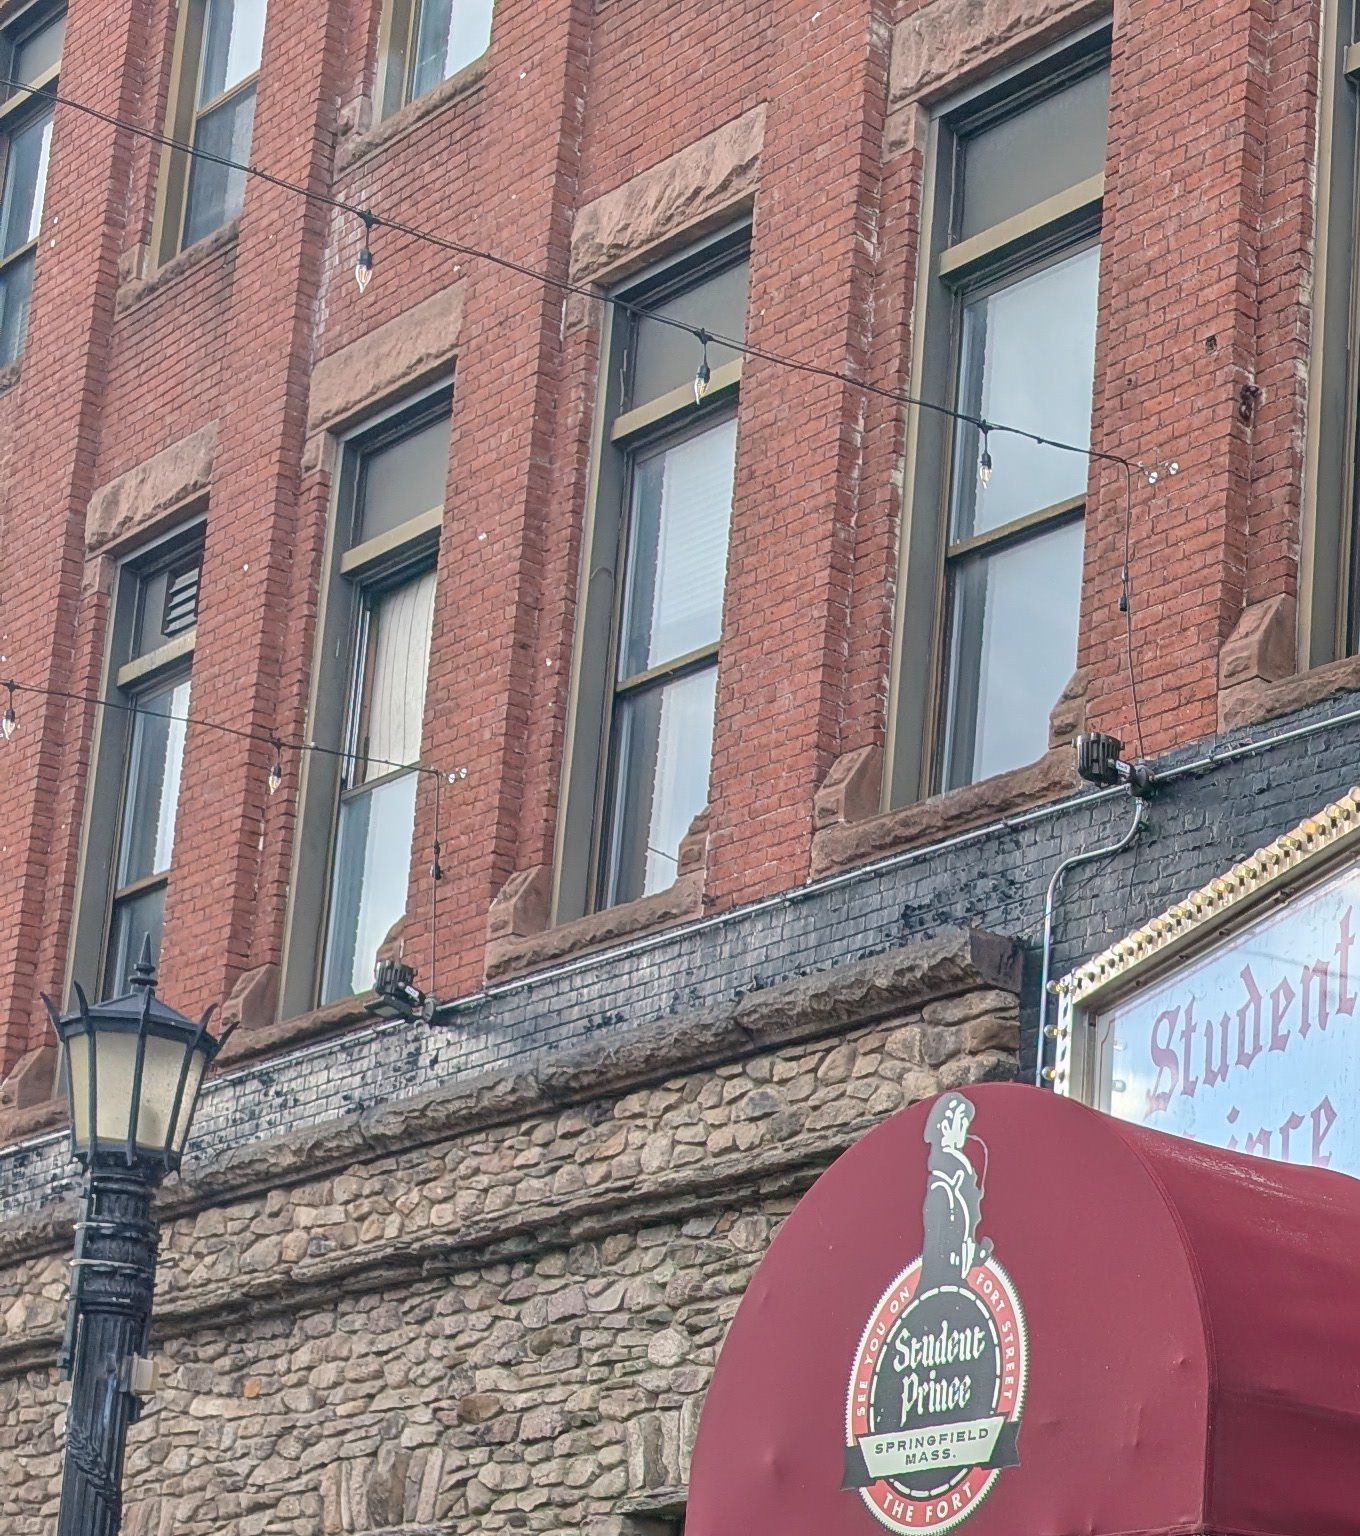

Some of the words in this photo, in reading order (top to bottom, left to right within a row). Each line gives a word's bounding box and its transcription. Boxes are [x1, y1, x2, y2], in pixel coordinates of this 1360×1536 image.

[1144, 904, 1358, 1120] Student
[856, 1380, 869, 1417] SEE
[864, 1321, 886, 1365] YOU
[890, 1286, 910, 1314] ON
[893, 1320, 986, 1373] Student
[975, 1273, 1006, 1312] FORT
[1001, 1320, 1015, 1398] STREET
[901, 1370, 971, 1427] Prince
[874, 1428, 989, 1455] SPRINGFIELD
[905, 1448, 957, 1466] MASS.
[883, 1492, 914, 1523] THE
[925, 1481, 973, 1523] FORT
